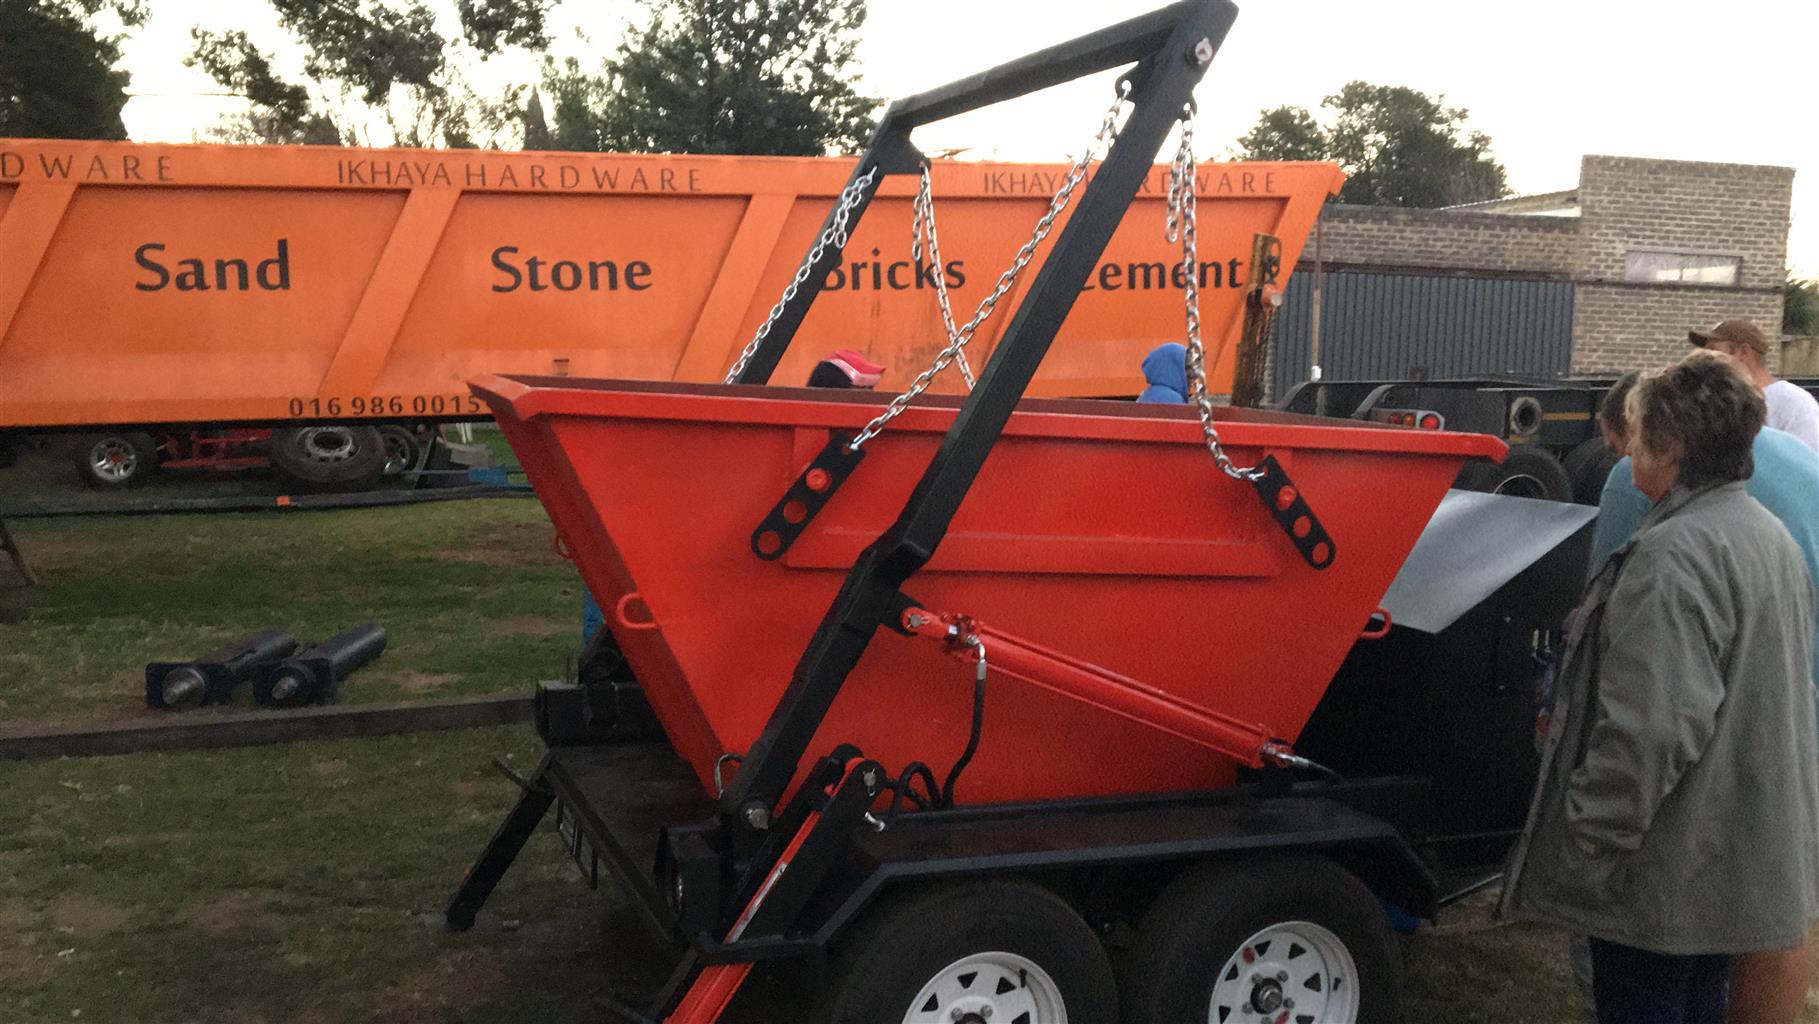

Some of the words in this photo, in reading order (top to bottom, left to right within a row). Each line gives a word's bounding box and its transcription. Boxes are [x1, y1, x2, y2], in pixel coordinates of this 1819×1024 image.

[1, 152, 174, 181] DWARE
[337, 160, 451, 187] IKHAYA
[465, 164, 702, 191] HARDWARE
[134, 238, 291, 292] Sand
[490, 245, 653, 293] Stone
[1081, 257, 1244, 291] ement
[289, 397, 342, 418] 016
[351, 396, 403, 416] 986
[412, 394, 481, 415] 0015
